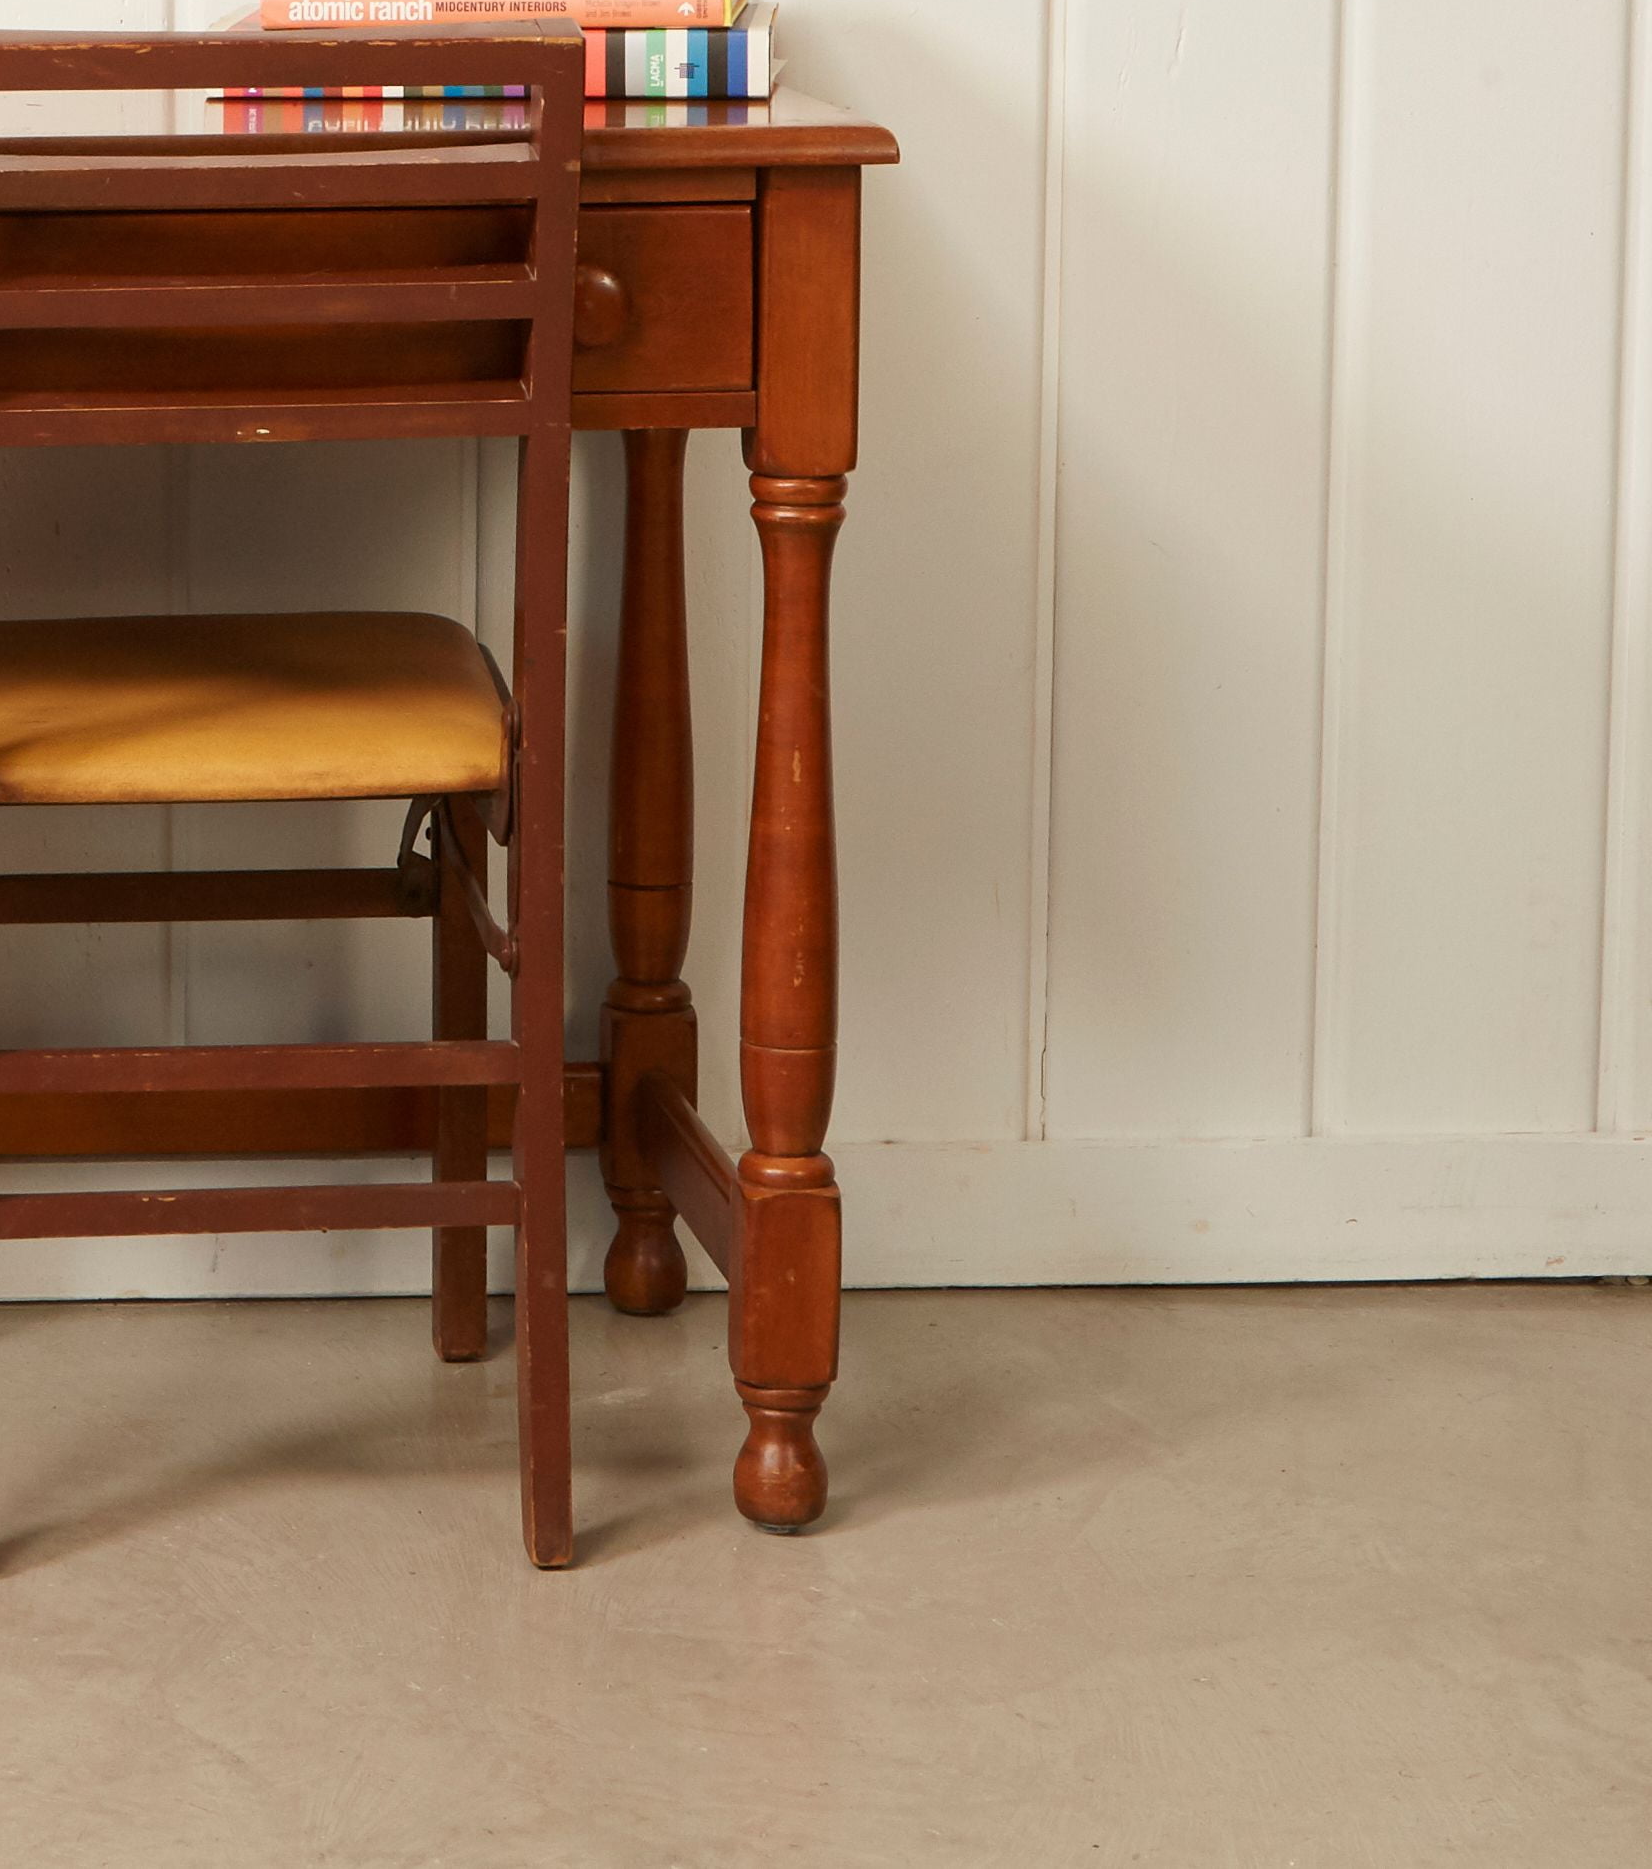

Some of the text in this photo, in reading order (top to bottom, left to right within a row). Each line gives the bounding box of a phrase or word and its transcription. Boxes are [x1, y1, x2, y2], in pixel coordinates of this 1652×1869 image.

[435, 1, 505, 12] MIDCENTURY
[509, 1, 567, 12] INTERIORS
[651, 54, 663, 87] LACMA
